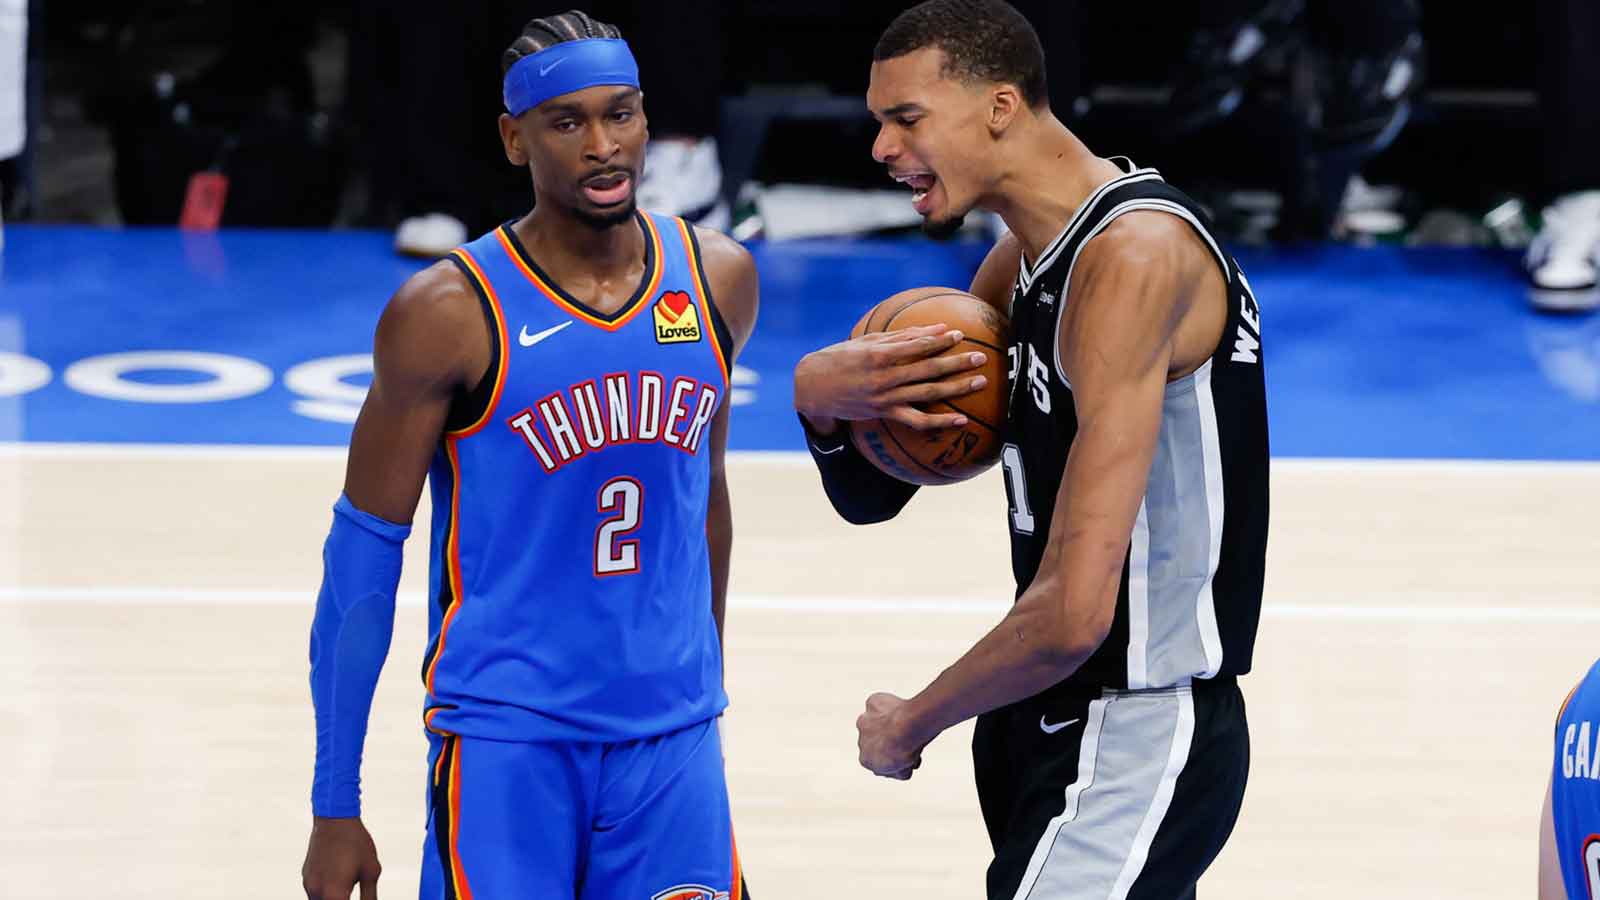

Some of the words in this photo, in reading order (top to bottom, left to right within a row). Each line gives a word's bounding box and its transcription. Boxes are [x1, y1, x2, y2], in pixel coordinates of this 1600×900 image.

[509, 371, 717, 472] THUNDER
[594, 476, 643, 576] 2
[1000, 443, 1034, 535] 1
